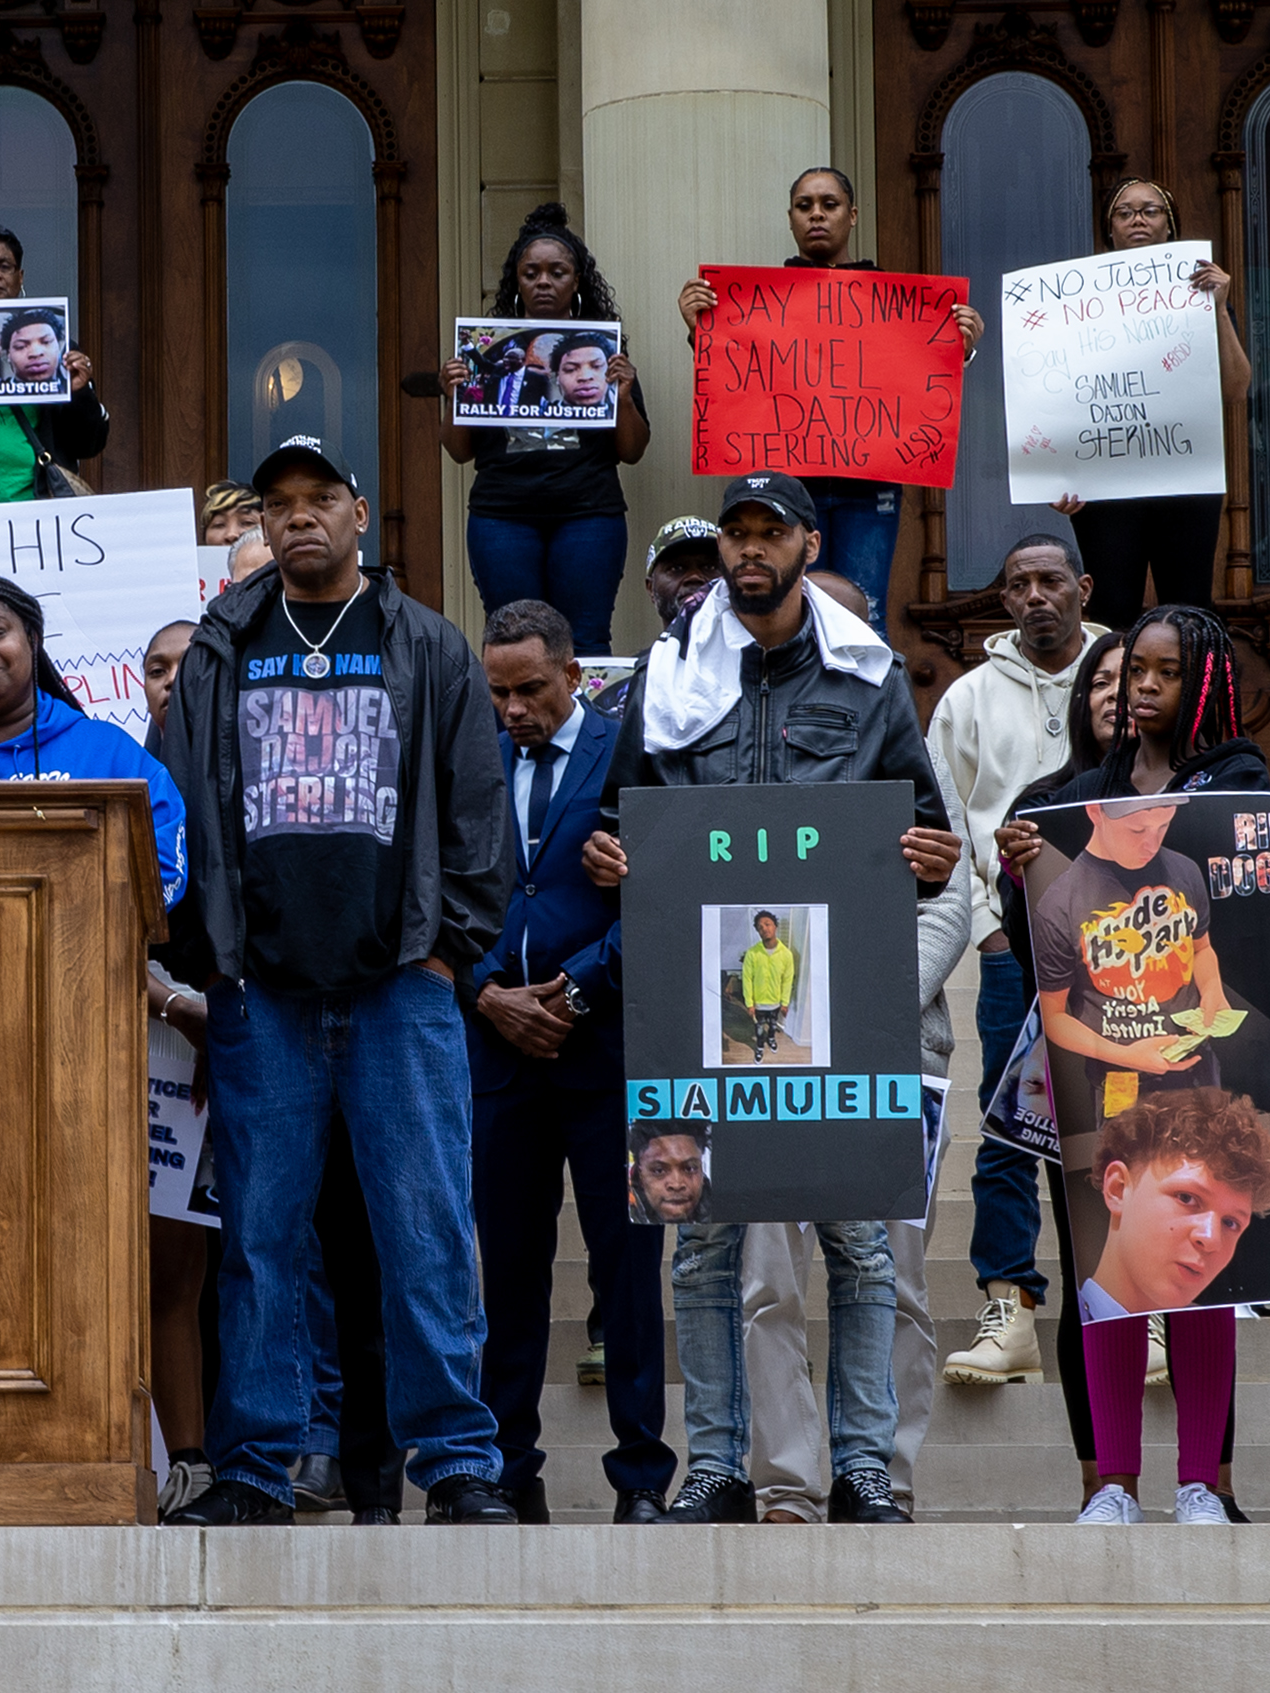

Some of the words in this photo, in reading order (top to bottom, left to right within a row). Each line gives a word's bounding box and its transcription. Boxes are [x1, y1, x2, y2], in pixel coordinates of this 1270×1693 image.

[726, 282, 795, 327] SAY
[817, 280, 863, 329] HIS
[871, 282, 934, 323] NAME
[724, 338, 883, 392] SAMUEL
[1074, 370, 1160, 404] SAMUEL
[460, 403, 507, 416] RALLY
[510, 404, 540, 417] FOR
[544, 405, 606, 418] JUSTICE
[772, 393, 901, 439] DAJON
[1090, 402, 1148, 424] DAJON
[724, 431, 871, 469] STERLING
[7, 512, 106, 574] HIS
[63, 663, 145, 707] RLIN
[248, 654, 288, 680] SAY
[335, 653, 383, 676] NAM
[246, 688, 398, 739] SAMUEL
[260, 732, 380, 783] DAJON
[244, 776, 398, 846] STERLING
[148, 1077, 191, 1101] TICE
[637, 1080, 909, 1118] SAMUEL
[1020, 1127, 1061, 1153] RLING
